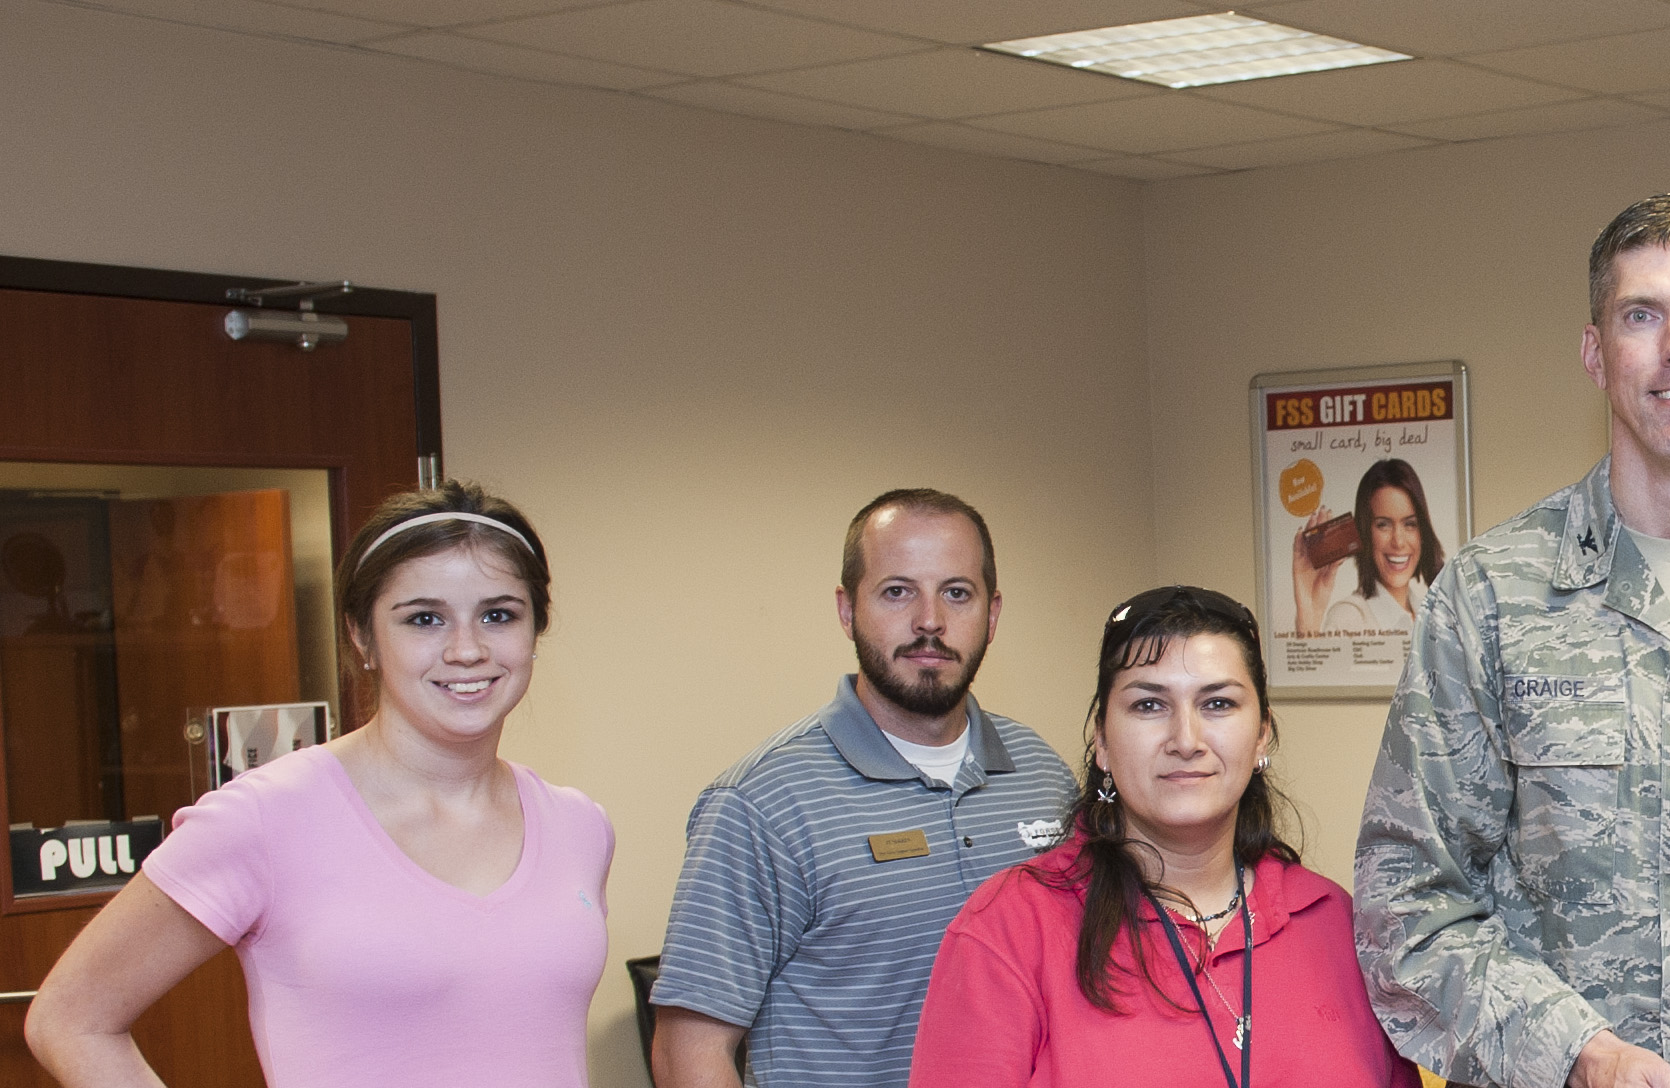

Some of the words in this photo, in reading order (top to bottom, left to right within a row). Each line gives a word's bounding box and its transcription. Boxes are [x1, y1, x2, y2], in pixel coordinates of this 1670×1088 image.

[1275, 397, 1314, 426] FSS
[1319, 393, 1367, 424] GIFT
[1371, 388, 1446, 421] CARDS
[1291, 431, 1323, 452] small
[1329, 430, 1366, 452] card,
[1375, 431, 1391, 452] big
[1399, 424, 1428, 445] deal
[1514, 678, 1585, 697] CRAIGE
[40, 834, 135, 881] PULL
